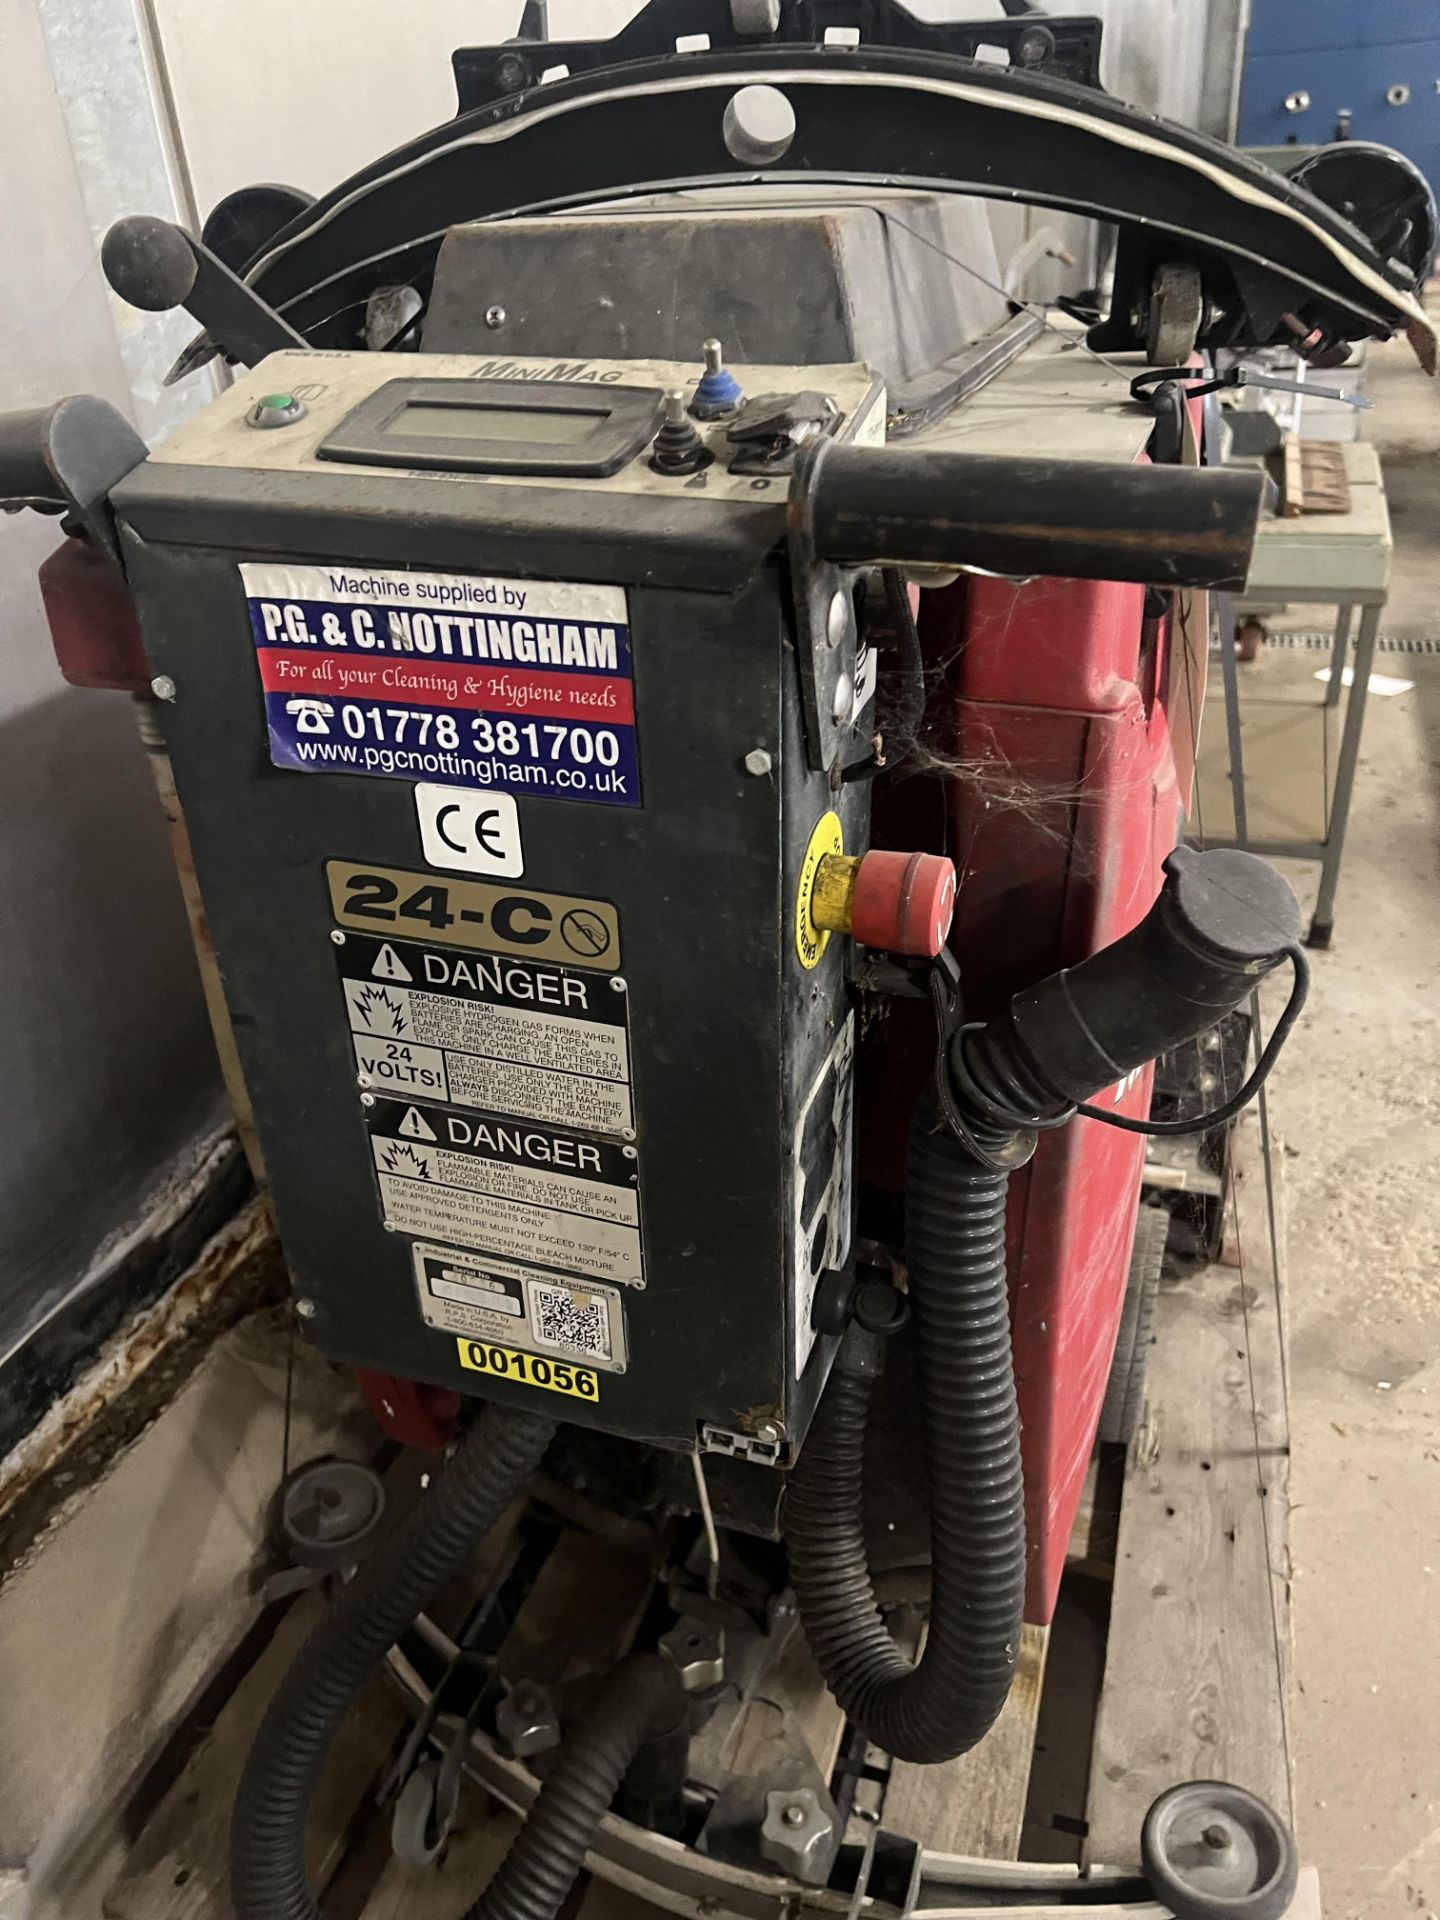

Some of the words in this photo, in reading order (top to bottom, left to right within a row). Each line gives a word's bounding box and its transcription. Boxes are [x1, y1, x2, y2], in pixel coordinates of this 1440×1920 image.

[331, 575, 409, 597] Machine
[417, 582, 496, 605] supplied
[504, 588, 526, 609] by
[261, 604, 317, 644] P.G.
[322, 612, 347, 646] &
[351, 609, 385, 650] C.
[390, 612, 618, 669] NOTTINGHAM
[276, 660, 304, 678] For
[312, 663, 332, 680] all
[339, 669, 376, 685] your
[382, 667, 458, 701] Cleaning
[464, 677, 482, 694] &
[488, 676, 563, 706] Hygiene
[570, 685, 616, 708] needs
[343, 704, 460, 750] 01778
[472, 718, 619, 766] 381700
[296, 742, 626, 794] www.pgcnottingham.co.uk
[436, 804, 506, 859] CE
[343, 875, 552, 944] 24-C
[407, 990, 464, 1008] EXPLOSION
[466, 1001, 494, 1013] RISK!
[423, 954, 589, 1009] DANGER
[408, 999, 461, 1016] EXPLOSIVE
[463, 1009, 519, 1027] HYDROGEN
[521, 1020, 542, 1031] GAS
[545, 1024, 581, 1038] FORMS
[583, 1031, 614, 1044] WHEN
[410, 1008, 462, 1025] BATTERIES
[464, 1018, 483, 1028] ARE
[543, 1032, 557, 1042] AN
[560, 1035, 589, 1047] OPEN
[411, 1016, 443, 1029] FLAME
[445, 1022, 459, 1032] OR
[461, 1025, 493, 1039] SPARK
[495, 1031, 516, 1043] CAN
[518, 1036, 552, 1049] CAUSE
[555, 1042, 577, 1054] THIS
[580, 1047, 601, 1058] GAS
[603, 1051, 617, 1061] TO
[384, 1043, 412, 1063] 24
[414, 1033, 435, 1044] THIS
[437, 1038, 481, 1053] MACHINE
[484, 1046, 494, 1055] IN
[496, 1048, 503, 1057] A
[504, 1050, 531, 1062] WELL
[534, 1055, 592, 1073] VENTILATED
[461, 1034, 486, 1046] ONLY
[488, 1039, 530, 1054] CHARGE
[532, 1047, 552, 1058] THE
[555, 1051, 608, 1068] BATTERIES
[611, 1061, 621, 1070] IN
[360, 1057, 443, 1089] VOLTS!
[446, 1053, 466, 1064] USE
[468, 1057, 493, 1069] ONLY
[495, 1062, 543, 1079] DISTILLED
[545, 1072, 579, 1085] WATER
[582, 1079, 592, 1088] IN
[594, 1081, 615, 1092] THE
[448, 1070, 495, 1086] CHARGER
[497, 1079, 546, 1095] PROVIDED
[548, 1089, 573, 1100] WITH
[503, 1072, 523, 1083] USE
[525, 1076, 550, 1088] ONLY
[553, 1081, 572, 1092] THE
[575, 1086, 598, 1097] OEM
[449, 1078, 488, 1092] ALWAYS
[491, 1086, 554, 1105] DISCONNECT
[557, 1098, 575, 1109] THE
[579, 1103, 623, 1118] BATTERY
[451, 1086, 488, 1100] BEFORE
[491, 1094, 542, 1111] SERVICING
[545, 1104, 564, 1115] THE
[435, 1150, 487, 1167] EXPLOSION
[488, 1161, 514, 1172] RISK!
[447, 1117, 602, 1173] DANGER
[388, 1177, 400, 1186] TO
[401, 1180, 429, 1193] AVOID
[430, 1186, 469, 1201] DAMAGE
[471, 1195, 483, 1204] TO
[485, 1198, 505, 1209] THIS
[437, 1159, 490, 1177] FLAMMABLE
[493, 1171, 544, 1188] MATERIALS
[546, 1182, 566, 1193] CAN
[568, 1187, 600, 1200] CAUSE
[602, 1194, 616, 1204] AN
[438, 1166, 489, 1183] EXPLOSION
[491, 1177, 505, 1187] OR
[532, 1186, 546, 1196] DO
[549, 1189, 568, 1200] NOT
[570, 1194, 590, 1205] USE
[439, 1174, 491, 1192] FLAMMABLE
[492, 1185, 541, 1202] MATERIALS
[543, 1196, 553, 1205] IN
[555, 1199, 578, 1210] TANK
[580, 1204, 593, 1214] OR
[596, 1207, 617, 1218] PICK
[388, 1187, 408, 1197] USE
[408, 1191, 456, 1208] APPROVED
[458, 1202, 518, 1222] DETERGENTS
[520, 1215, 544, 1227] ONLY
[391, 1200, 422, 1214] WATER
[423, 1208, 487, 1229] TEMPERATURE
[489, 1222, 514, 1234] MUST
[516, 1228, 536, 1239] NOT
[538, 1233, 575, 1248] EXCEED
[622, 1251, 630, 1260] C
[393, 1214, 407, 1224] DO
[409, 1218, 427, 1229] NOT
[429, 1222, 448, 1233] USE
[449, 1227, 533, 1253] HIGH-PERCENTAGE
[535, 1246, 572, 1261] BLEACH
[574, 1255, 614, 1271] MIXTURE
[424, 1247, 462, 1261] Industrial
[471, 1258, 519, 1275] Commercial
[521, 1269, 557, 1283] Cleaning
[560, 1278, 605, 1295] Equipment
[452, 1265, 477, 1277] Serial
[468, 1343, 595, 1396] 001056
